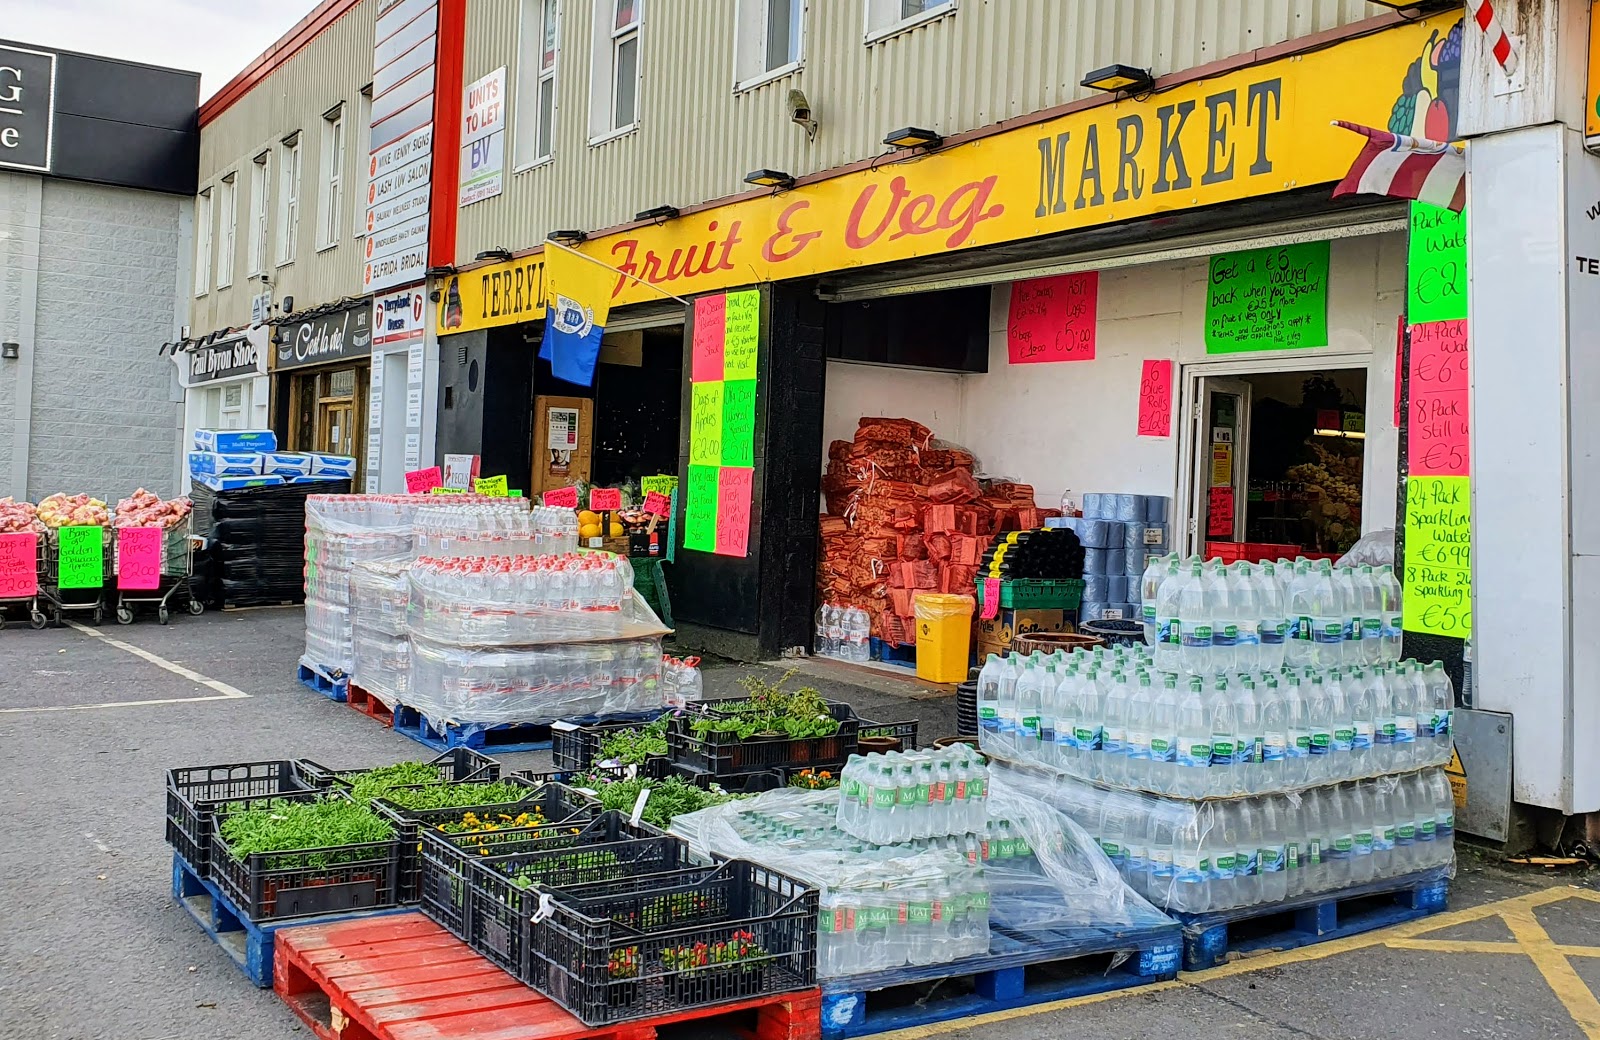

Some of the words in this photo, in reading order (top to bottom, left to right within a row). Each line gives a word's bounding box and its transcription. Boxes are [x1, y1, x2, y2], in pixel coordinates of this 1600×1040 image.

[469, 78, 498, 109] UNITS
[466, 112, 478, 134] TO
[481, 102, 500, 128] LET
[378, 152, 391, 168] MIKE
[393, 142, 411, 162] KENNY
[412, 132, 430, 152] SIGNS
[471, 135, 491, 169] BV
[1034, 76, 1283, 219] MARKET
[377, 178, 393, 196] LASH
[395, 172, 406, 190] LUV
[408, 162, 430, 184] SALON
[412, 194, 428, 208] STUDIO
[1413, 209, 1447, 233] Pack
[610, 219, 744, 300] Fruit
[761, 199, 823, 264] &
[1426, 231, 1468, 253] Wat
[373, 258, 398, 279] ELFRIDA
[401, 250, 425, 271] BRIDAL
[1211, 257, 1239, 285] Get
[1246, 258, 1255, 273] a
[1269, 262, 1314, 285] voucher
[481, 261, 547, 318] TERRYL
[1211, 286, 1238, 308] back
[1243, 282, 1267, 299] when
[1269, 285, 1285, 303] you
[1247, 298, 1267, 312] €25
[1211, 318, 1220, 327] on
[1238, 326, 1249, 335] and
[1413, 322, 1434, 344] 24
[1435, 320, 1463, 341] Pack
[319, 322, 329, 354] la
[191, 350, 207, 376] Paul
[207, 348, 232, 379] Byron
[1150, 360, 1161, 382] 6
[1139, 378, 1165, 397] Blue
[1146, 395, 1168, 412] Rolls
[1415, 398, 1427, 424] 8
[1431, 398, 1463, 421] Pack
[1406, 479, 1427, 509] 24
[1430, 480, 1461, 505] Pack
[1409, 508, 1471, 530] Sparklin
[65, 527, 91, 543] Bags
[118, 527, 143, 544] Bags
[1406, 566, 1416, 583] 8
[1420, 567, 1450, 583] Pack
